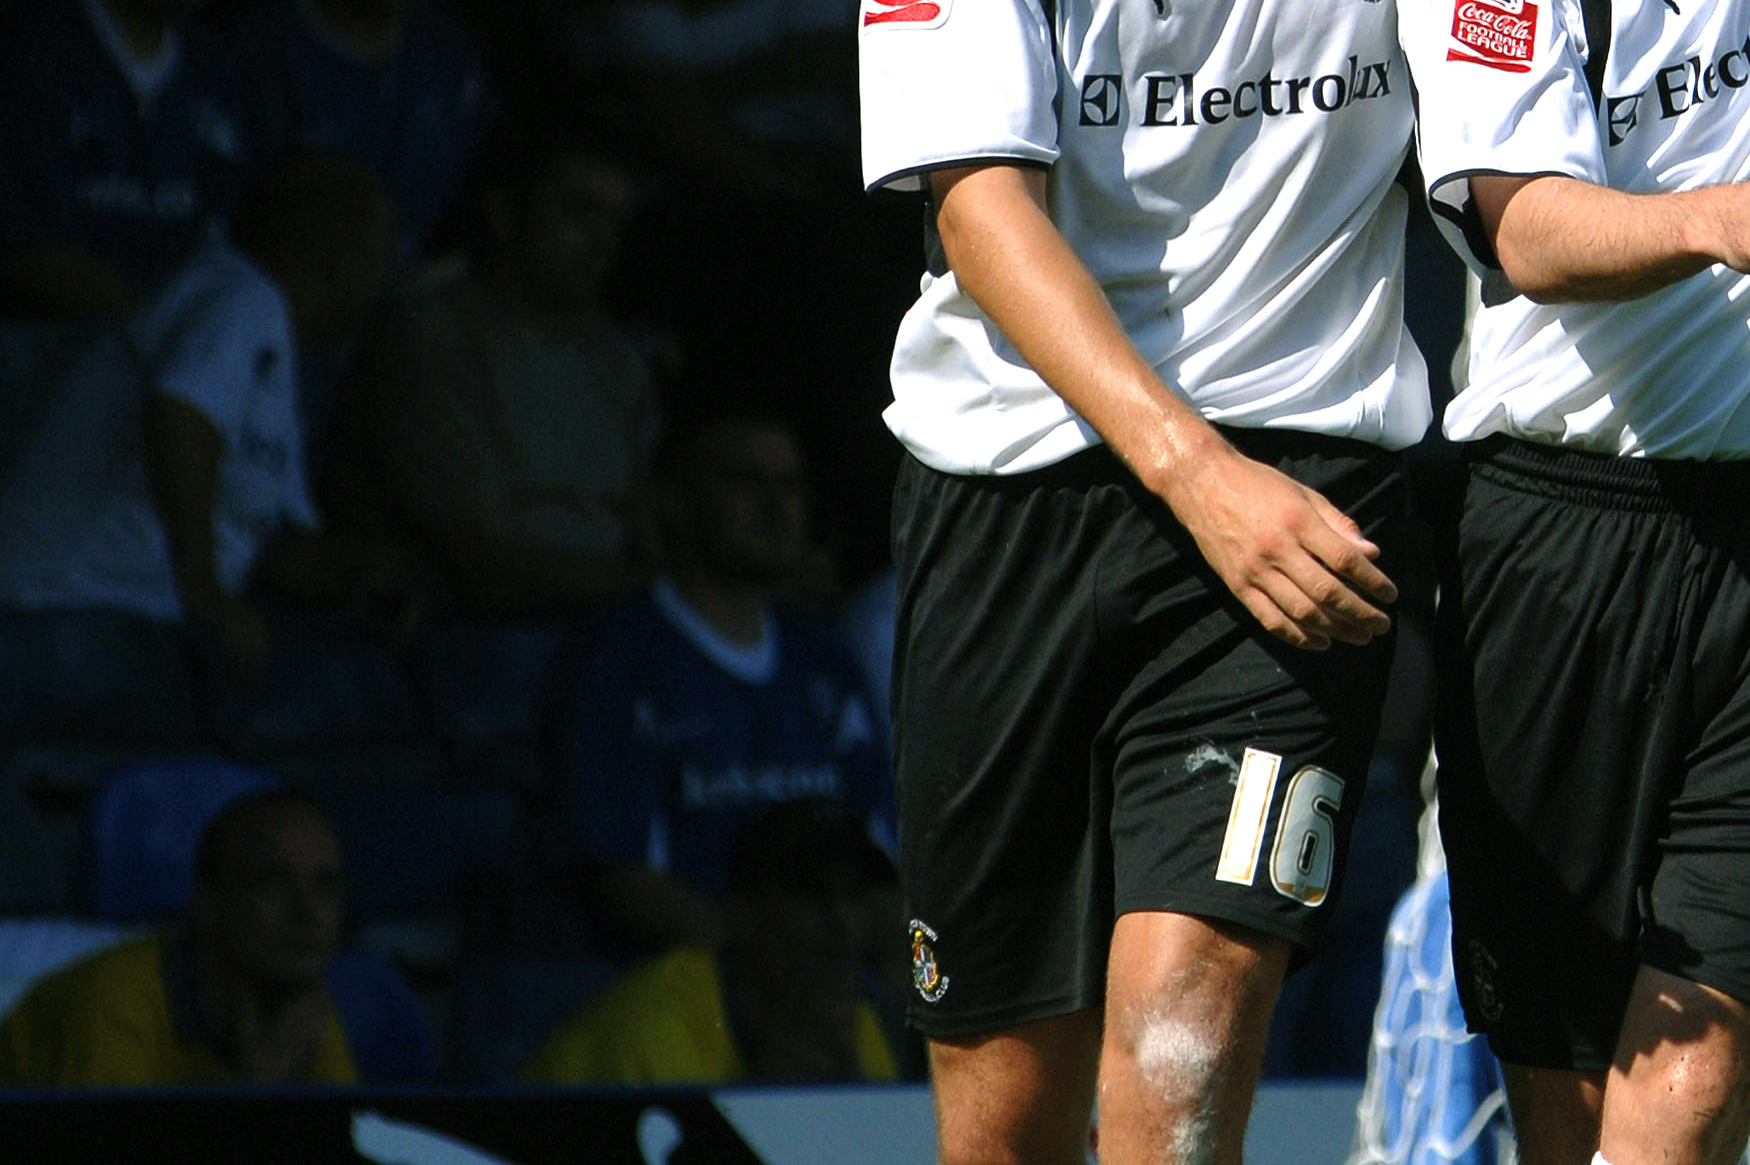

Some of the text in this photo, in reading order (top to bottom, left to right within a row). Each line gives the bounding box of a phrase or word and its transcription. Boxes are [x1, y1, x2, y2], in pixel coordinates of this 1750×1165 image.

[1458, 2, 1532, 40] Coca-Cola
[1459, 21, 1525, 47] FOOTBALL
[1457, 30, 1528, 58] LEAGUE
[1139, 54, 1392, 127] Electrolux
[1215, 746, 1345, 907] 16
